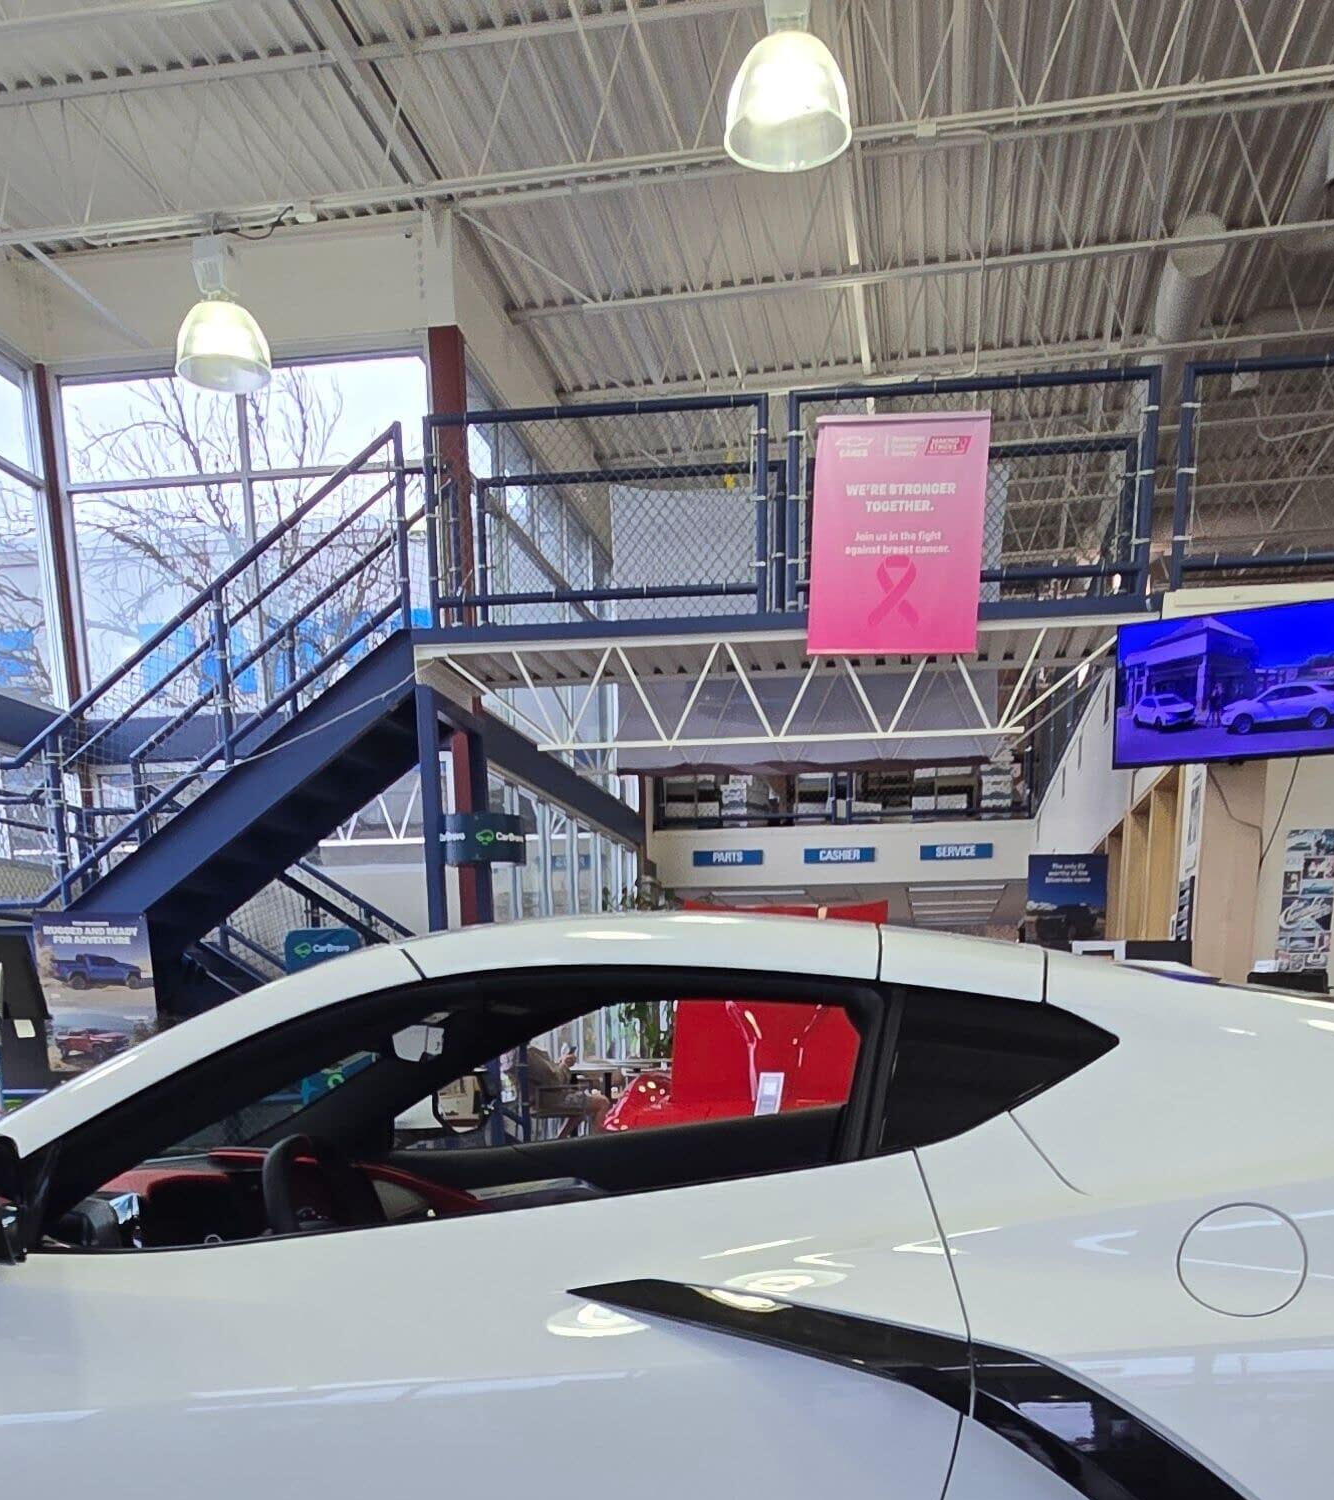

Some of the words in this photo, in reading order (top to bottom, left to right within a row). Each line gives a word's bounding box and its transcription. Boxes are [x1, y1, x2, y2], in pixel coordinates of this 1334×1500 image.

[845, 484, 887, 496] WE'RE
[889, 482, 956, 496] STRONGER
[865, 499, 935, 512] TOGETHER.
[855, 531, 875, 542] Join
[875, 533, 887, 541] us
[889, 531, 899, 541] in
[900, 531, 917, 541] the
[918, 530, 942, 543] fight
[845, 545, 881, 557] against
[882, 545, 914, 555] breast
[915, 545, 951, 554] cancer.
[712, 851, 743, 864] PARTS
[819, 849, 861, 861] CASHIER
[935, 845, 976, 858] SERVICE
[43, 925, 83, 936] RUGGED
[84, 926, 105, 936] AND
[105, 926, 138, 937] READY
[53, 935, 73, 945] FOR
[74, 936, 132, 945] ADVENTURE
[312, 943, 351, 953] CarBravo
